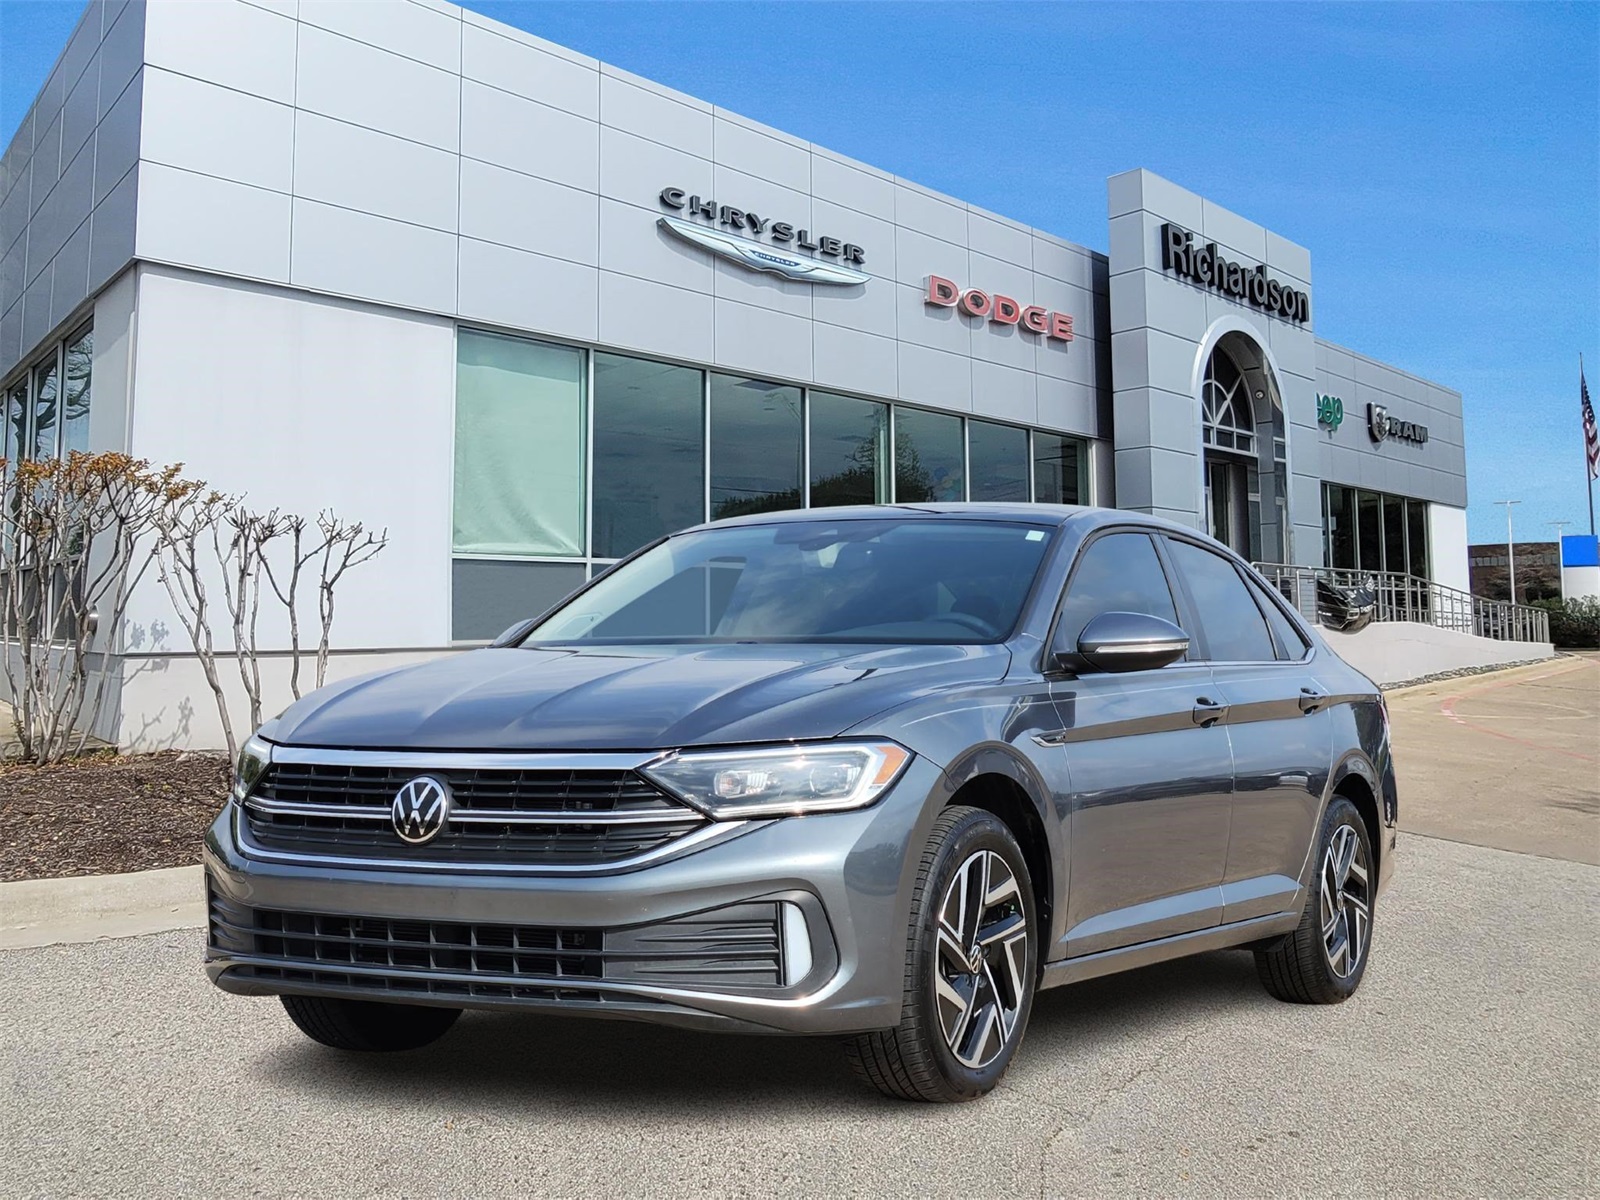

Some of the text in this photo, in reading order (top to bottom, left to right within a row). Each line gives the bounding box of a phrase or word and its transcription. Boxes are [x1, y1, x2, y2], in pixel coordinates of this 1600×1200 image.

[659, 187, 866, 264] CHRYSLER
[923, 275, 1074, 342] DODGE
[1161, 223, 1309, 323] Richardson
[1387, 417, 1428, 443] RAM
